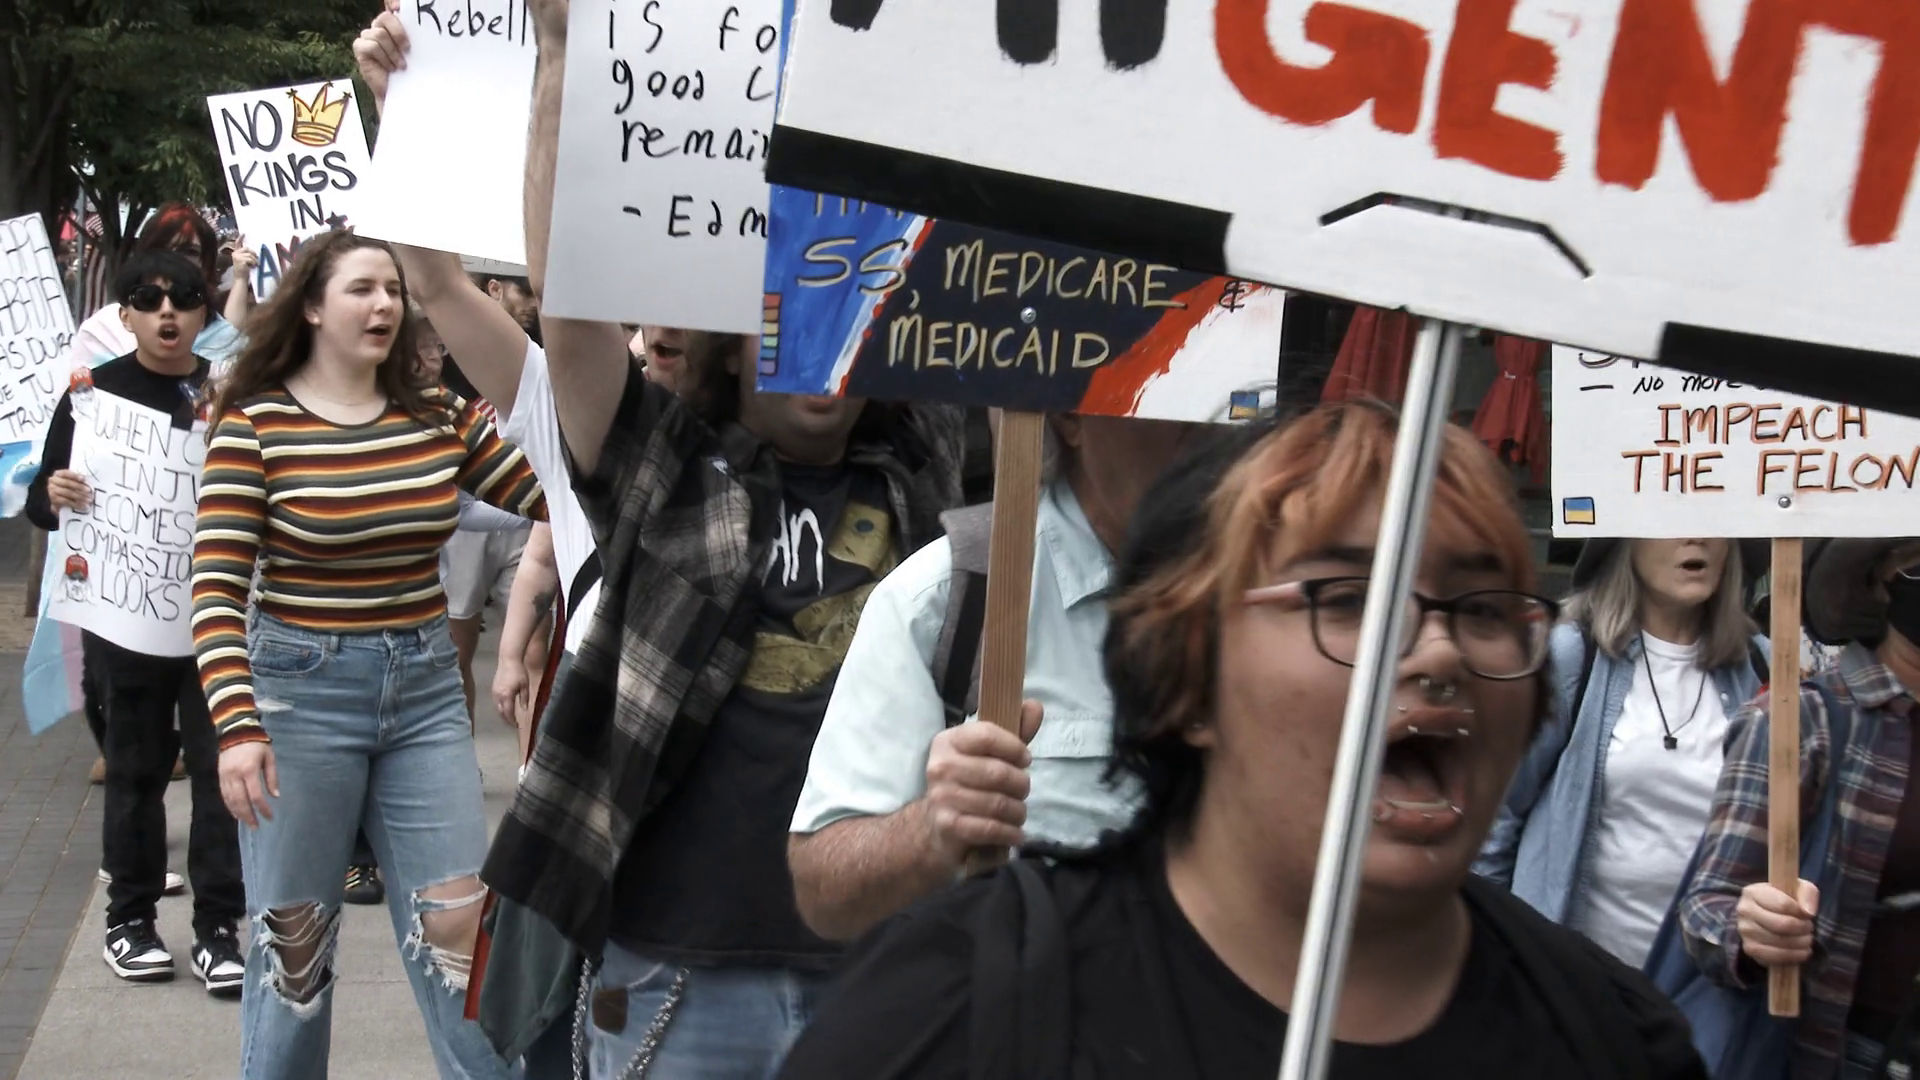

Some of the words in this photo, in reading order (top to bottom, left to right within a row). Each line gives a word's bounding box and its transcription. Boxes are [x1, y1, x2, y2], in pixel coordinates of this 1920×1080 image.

[609, 0, 664, 53] is
[612, 59, 704, 115] good
[221, 100, 282, 155] NO
[229, 150, 357, 207] KINGS
[290, 194, 324, 230] IN
[944, 239, 1188, 309] MEDICARE
[888, 306, 1111, 376] MEDICAID
[19, 371, 54, 402] TU
[94, 399, 172, 459] WHEN
[1654, 403, 1868, 447] IMPEACH
[1622, 450, 1725, 493] THE
[1757, 445, 1920, 495] FELON
[72, 487, 195, 549] ECOMES
[65, 518, 192, 583] COMPASSIO
[101, 551, 182, 622] LOOKS
